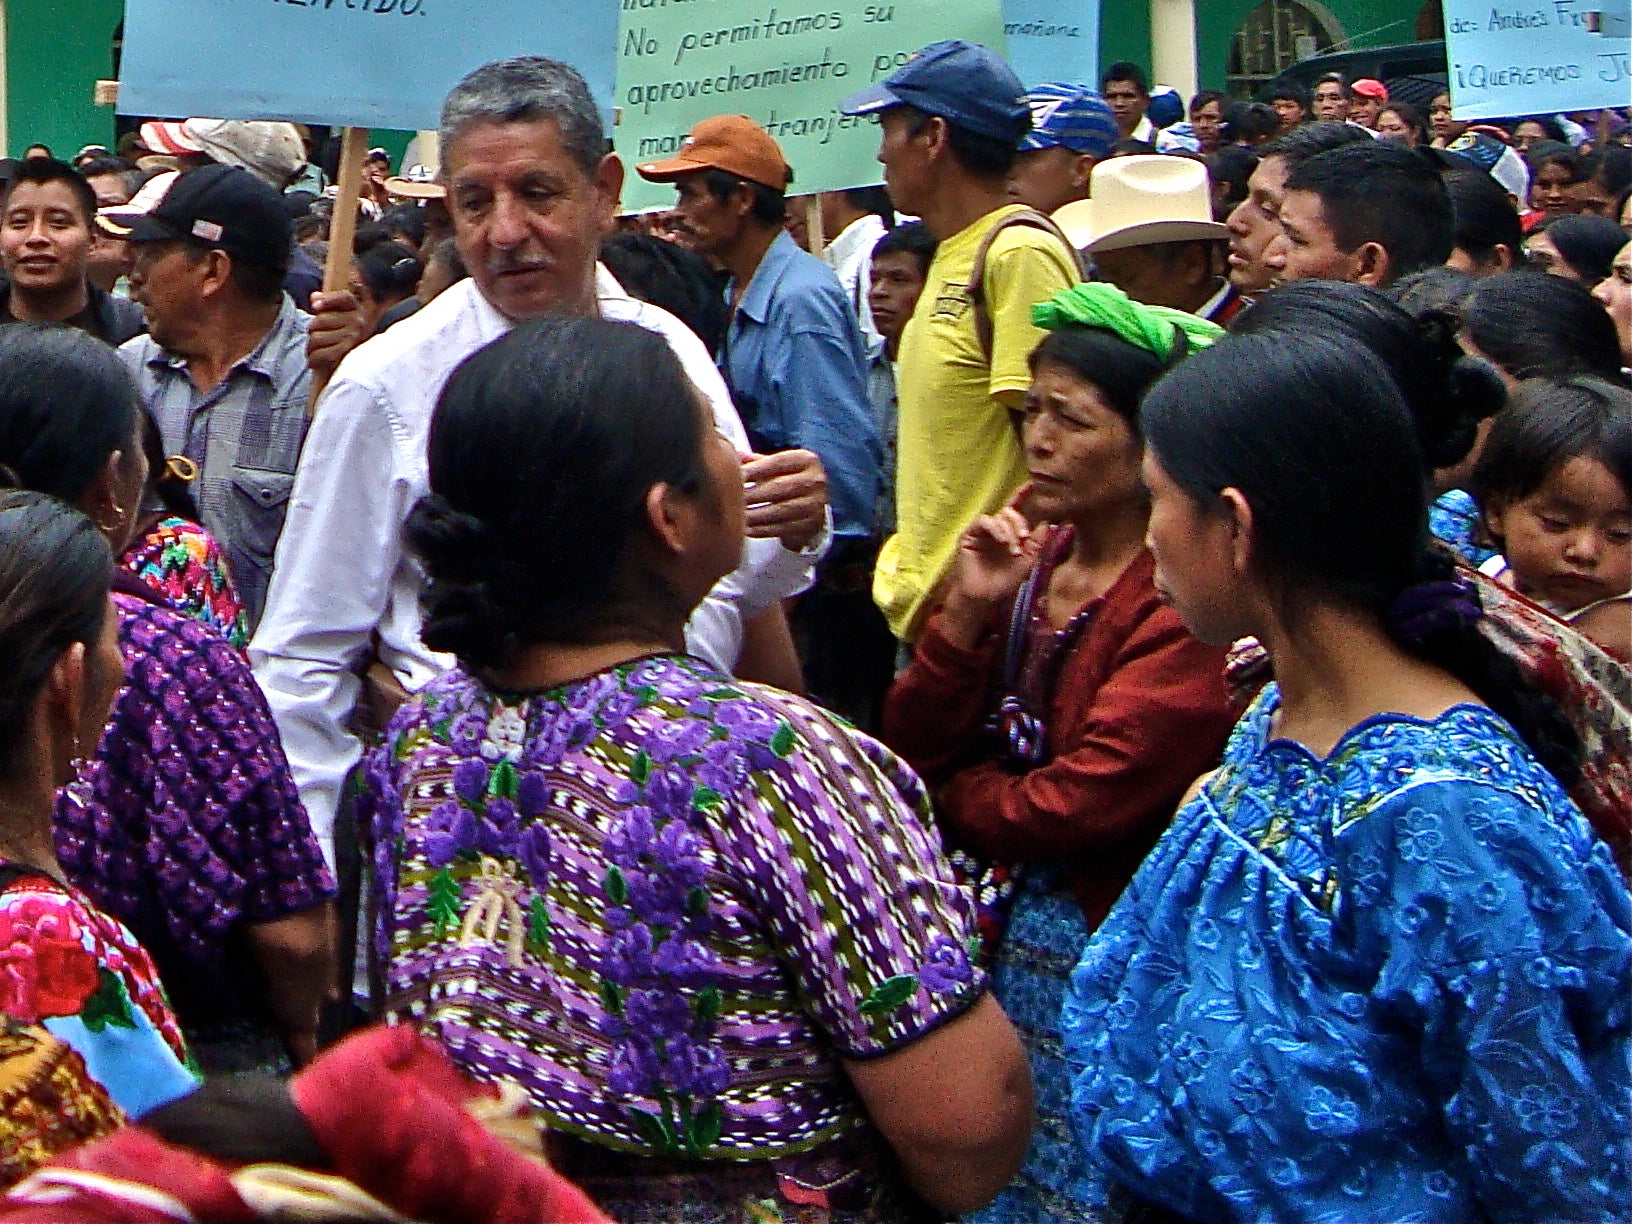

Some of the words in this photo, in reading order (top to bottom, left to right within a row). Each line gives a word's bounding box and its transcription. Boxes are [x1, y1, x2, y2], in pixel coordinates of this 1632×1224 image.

[624, 27, 658, 56] No
[675, 8, 843, 65] permitamos
[863, 5, 895, 25] su
[627, 46, 850, 114] aprovechamiento
[870, 51, 911, 82] po
